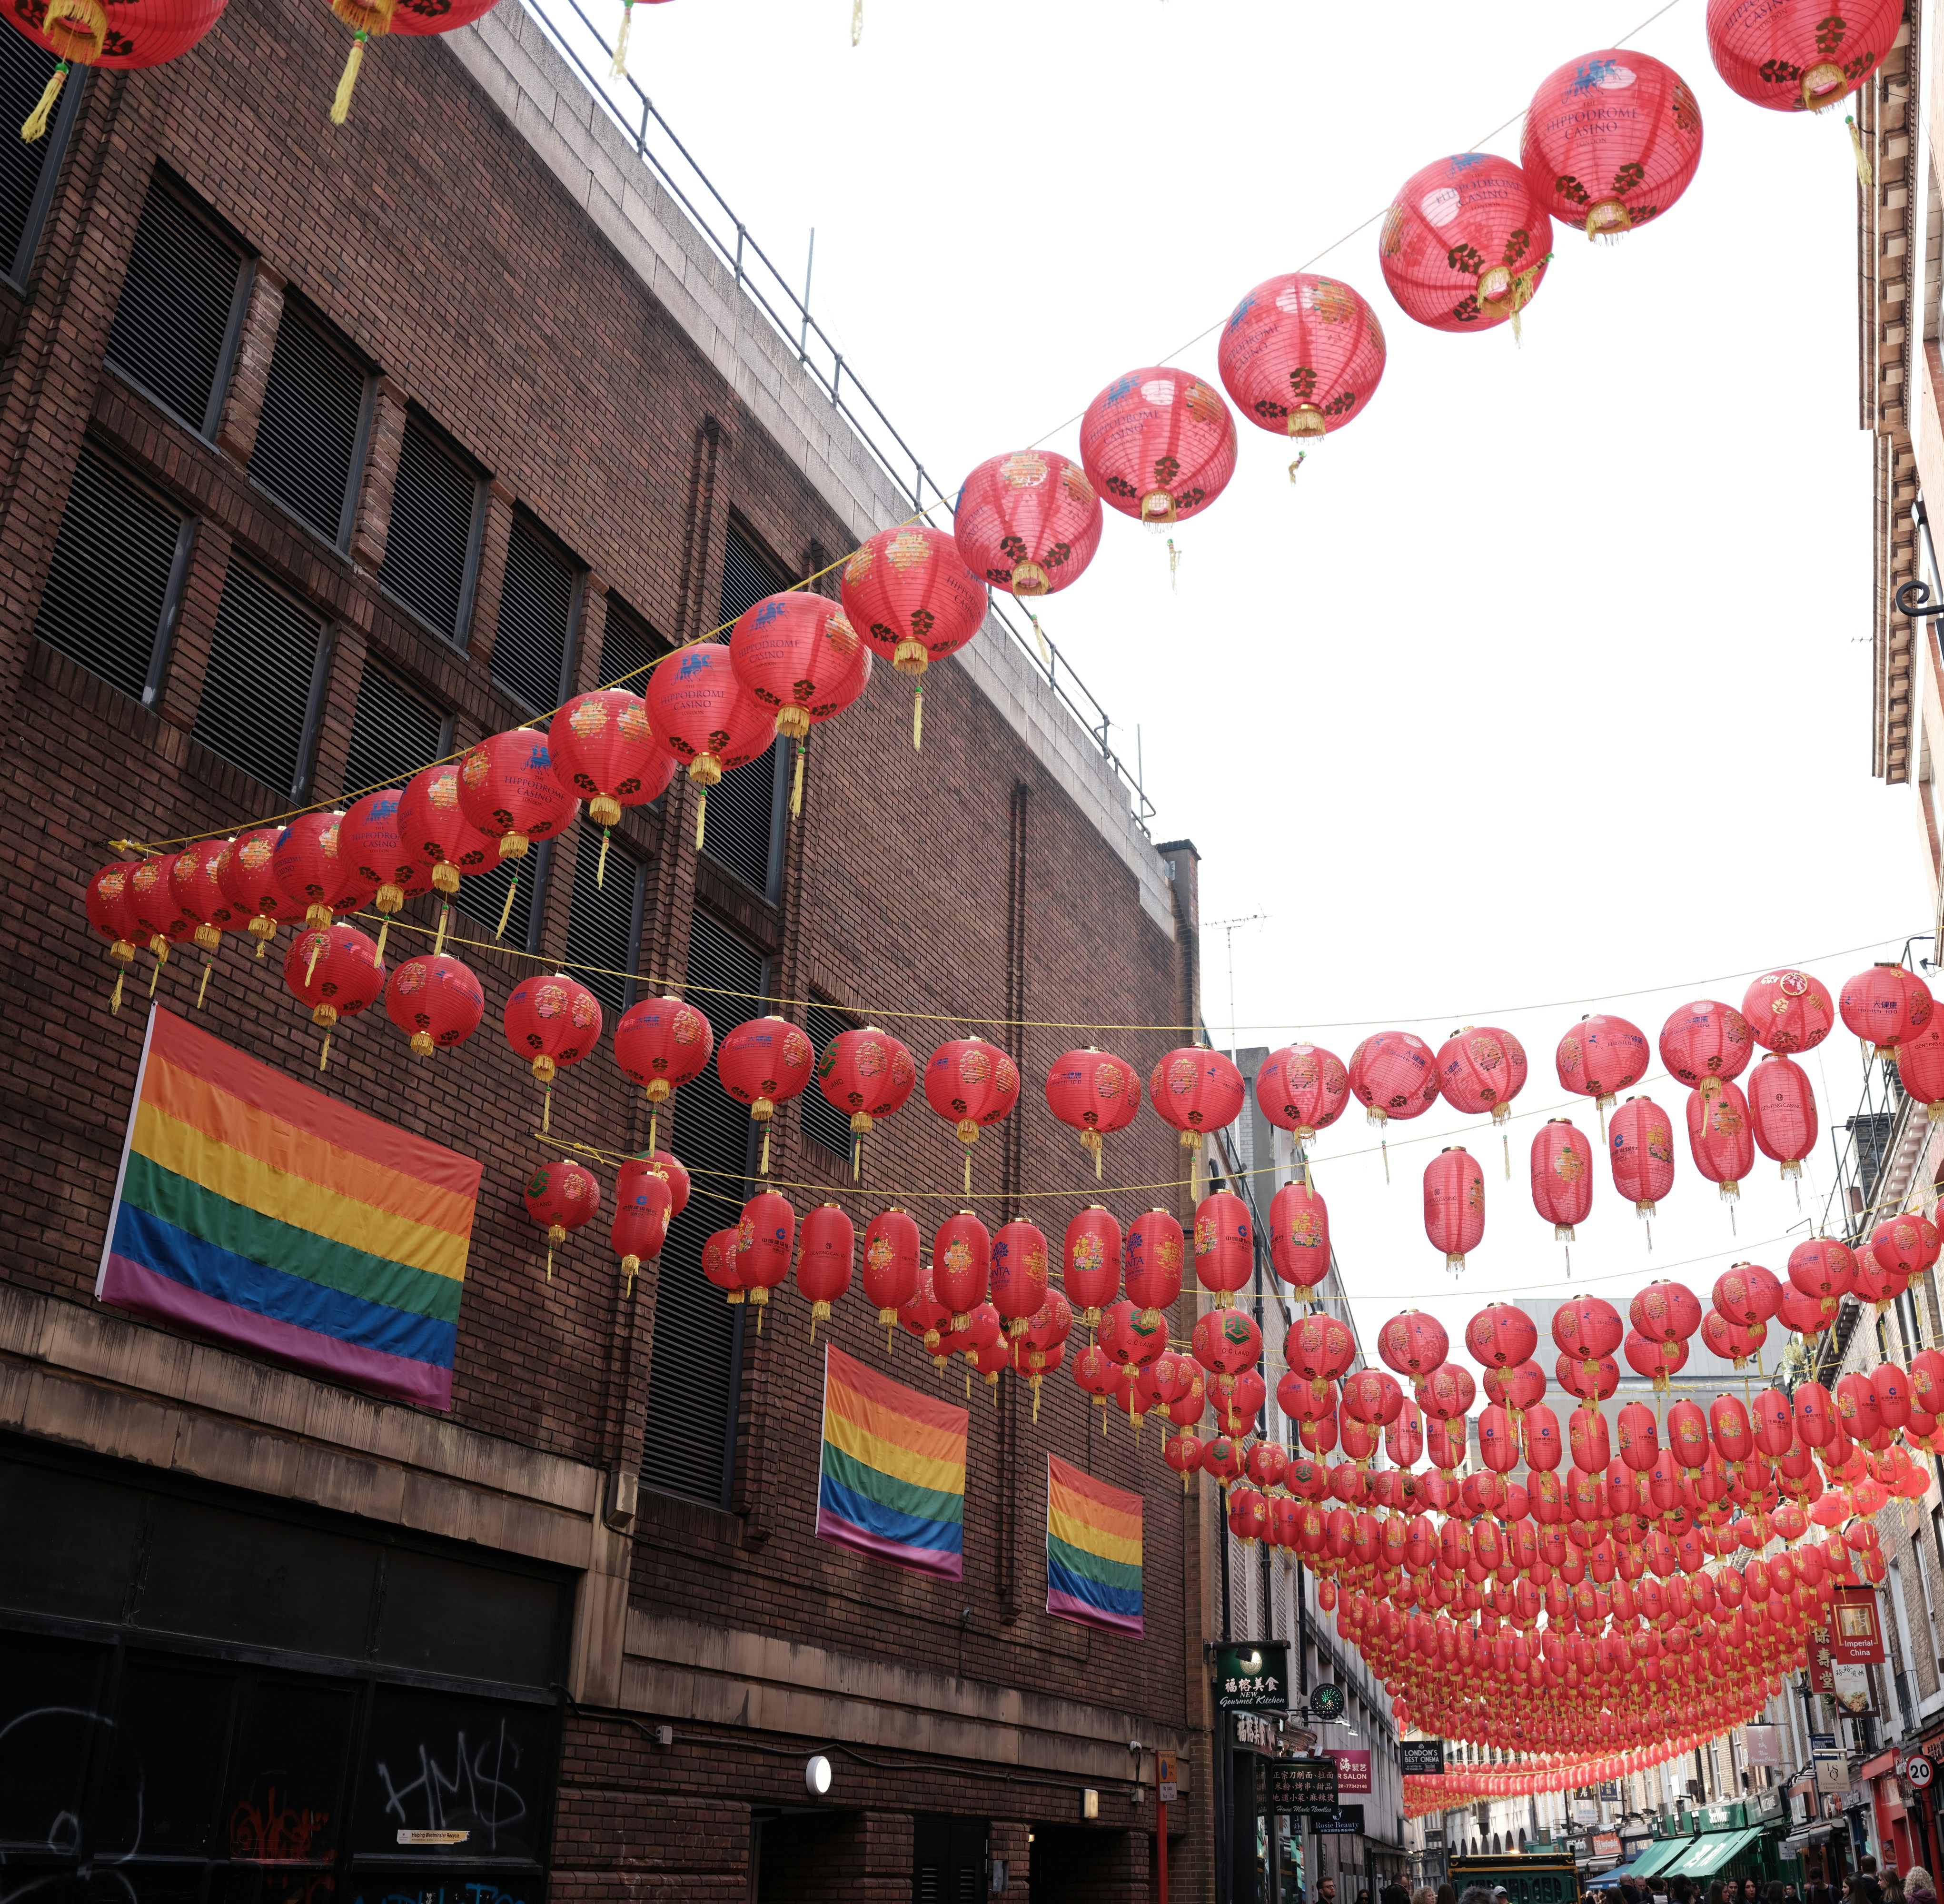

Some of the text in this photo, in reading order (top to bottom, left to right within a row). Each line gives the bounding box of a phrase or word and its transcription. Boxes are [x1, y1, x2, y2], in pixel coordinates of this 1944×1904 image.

[1547, 107, 1638, 133] HIPPODROME
[1565, 121, 1617, 139] CASINO
[1576, 137, 1607, 148] LONDON
[1436, 178, 1521, 204] HIPPODROME
[1458, 189, 1508, 206] CASINO
[1234, 342, 1268, 372] CASINO
[1090, 410, 1159, 442] HIPPODROME
[1103, 423, 1144, 445] CASINO
[738, 640, 800, 659] HIPPODROME
[749, 650, 784, 664] CASINO
[660, 690, 726, 705] HIPPODROME
[674, 700, 711, 711] CASINO
[505, 776, 565, 801] HIPPODROME
[517, 787, 552, 803] CASINO
[522, 797, 543, 806] LONDON
[1874, 1000, 1897, 1009] 大健康
[1914, 1041, 1938, 1050] GENTING
[1387, 1048, 1410, 1062] Health
[828, 1079, 844, 1091] LAND
[1761, 1103, 1782, 1112] GENTING
[1845, 1640, 1873, 1648] Imperial
[1225, 1676, 1279, 1693] 福榕美食
[1312, 1685, 1327, 1701] CHINATOWN
[1220, 1695, 1285, 1707] Gourmet Kitchen
[1910, 1764, 1929, 1779] 20
